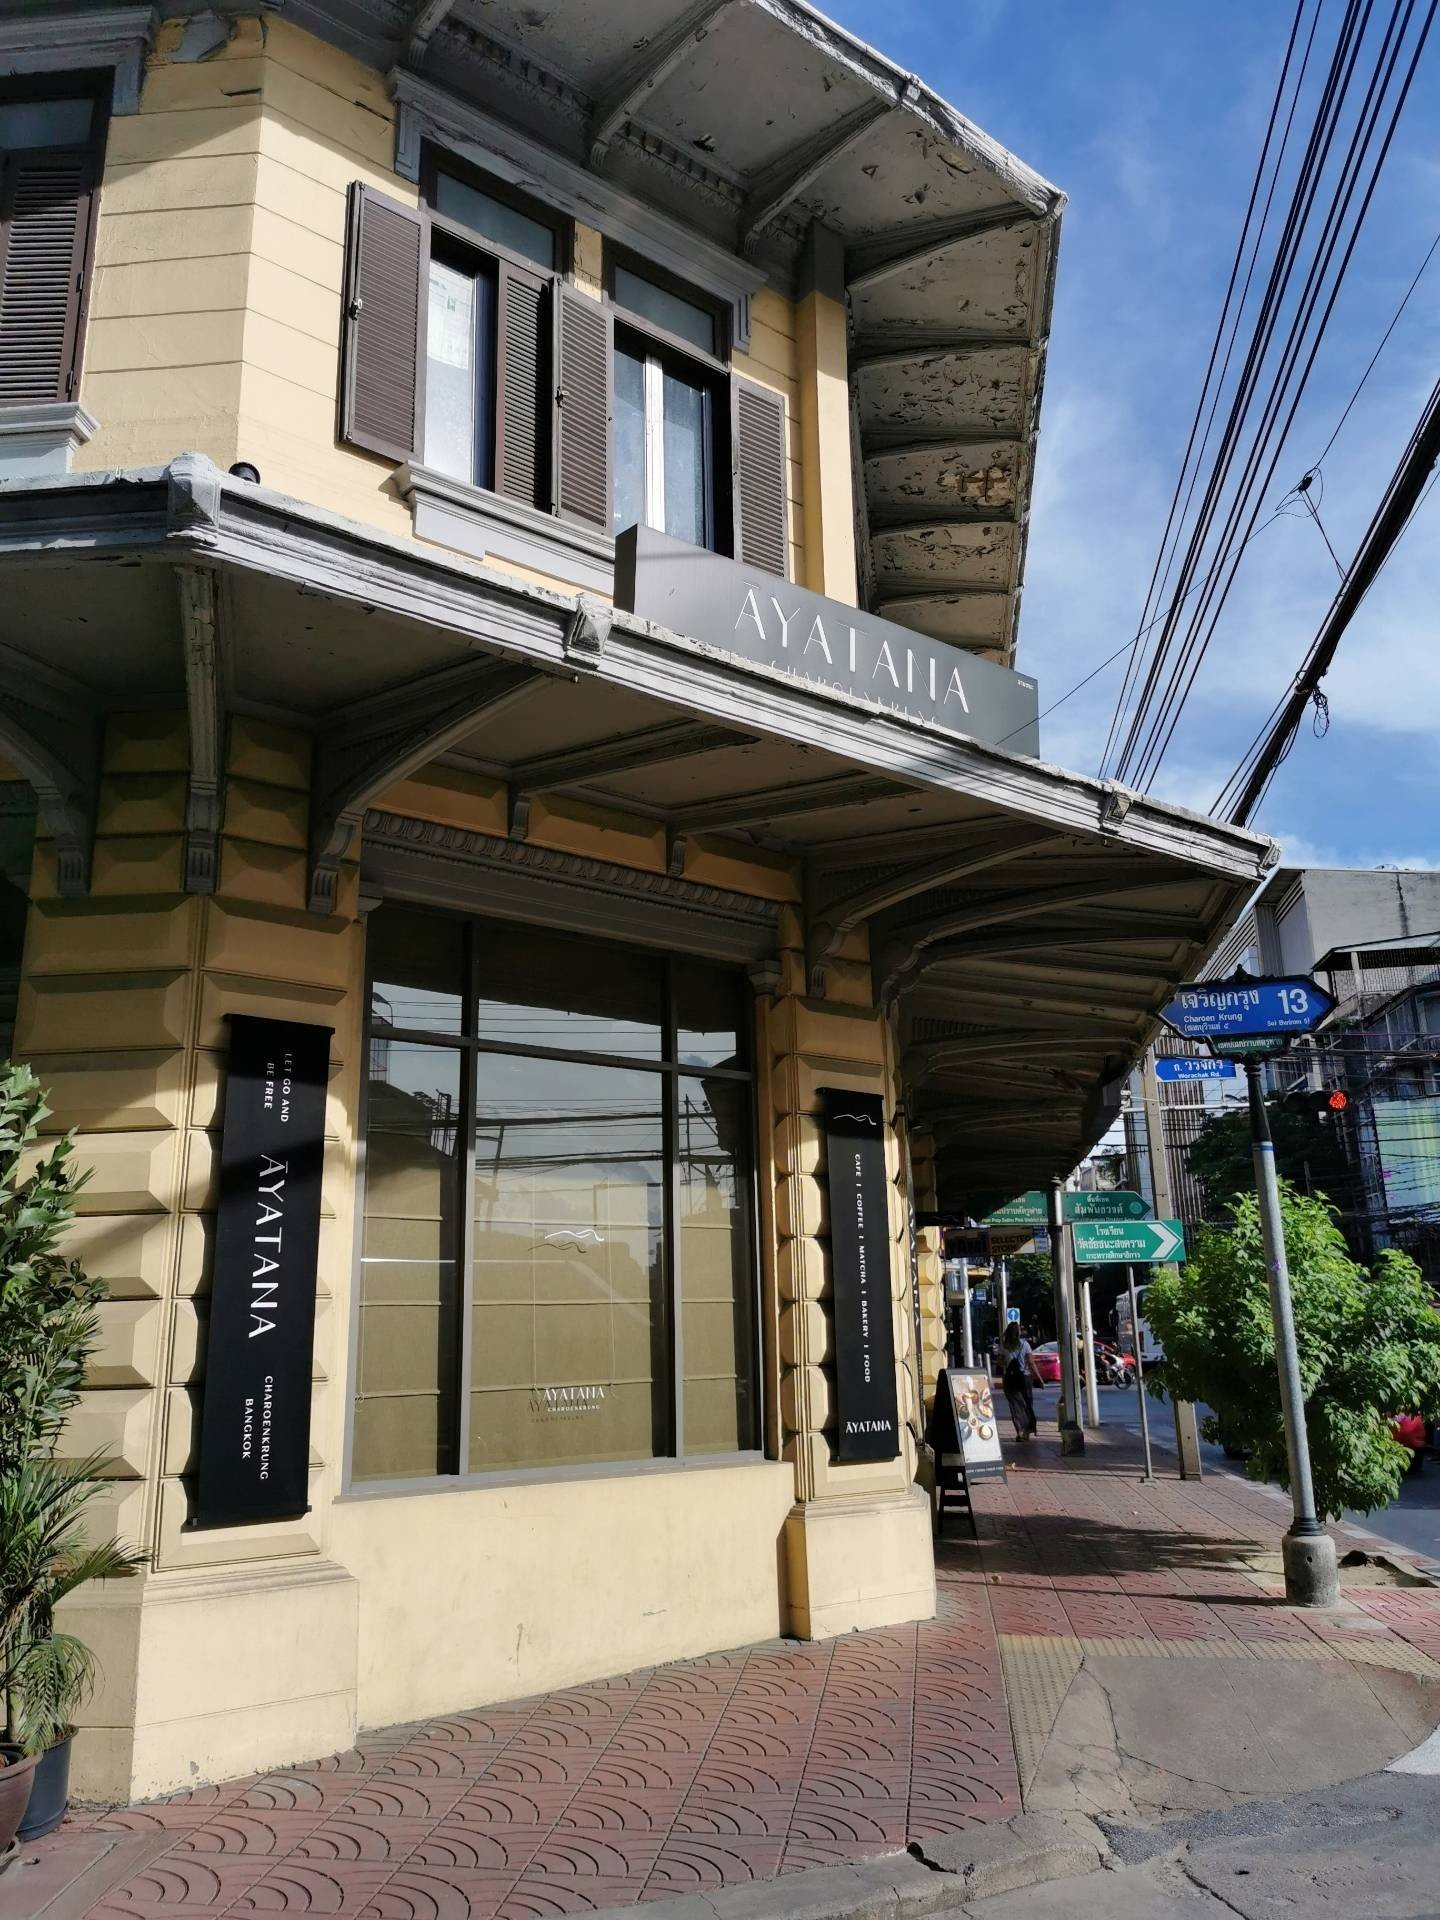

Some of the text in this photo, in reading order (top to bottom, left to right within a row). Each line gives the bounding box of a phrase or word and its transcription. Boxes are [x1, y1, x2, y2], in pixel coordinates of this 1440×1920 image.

[1182, 988, 1309, 1015] เจริญกรุง 13
[1184, 1013, 1243, 1023] Charoen Krung
[264, 1062, 275, 1110] BE FREE
[281, 1053, 292, 1123] LET GO AND
[1178, 1072, 1209, 1080] Worachak
[854, 1153, 862, 1177] CAFE
[856, 1193, 864, 1229] COFFEE
[1095, 1224, 1124, 1236] โรงเรียน
[859, 1245, 867, 1284] MATCHA
[861, 1300, 869, 1338] BAKERY
[863, 1354, 871, 1383] FOOD
[242, 1398, 253, 1459] BANGKOK
[260, 1375, 274, 1480] CHAROENKRUNG
